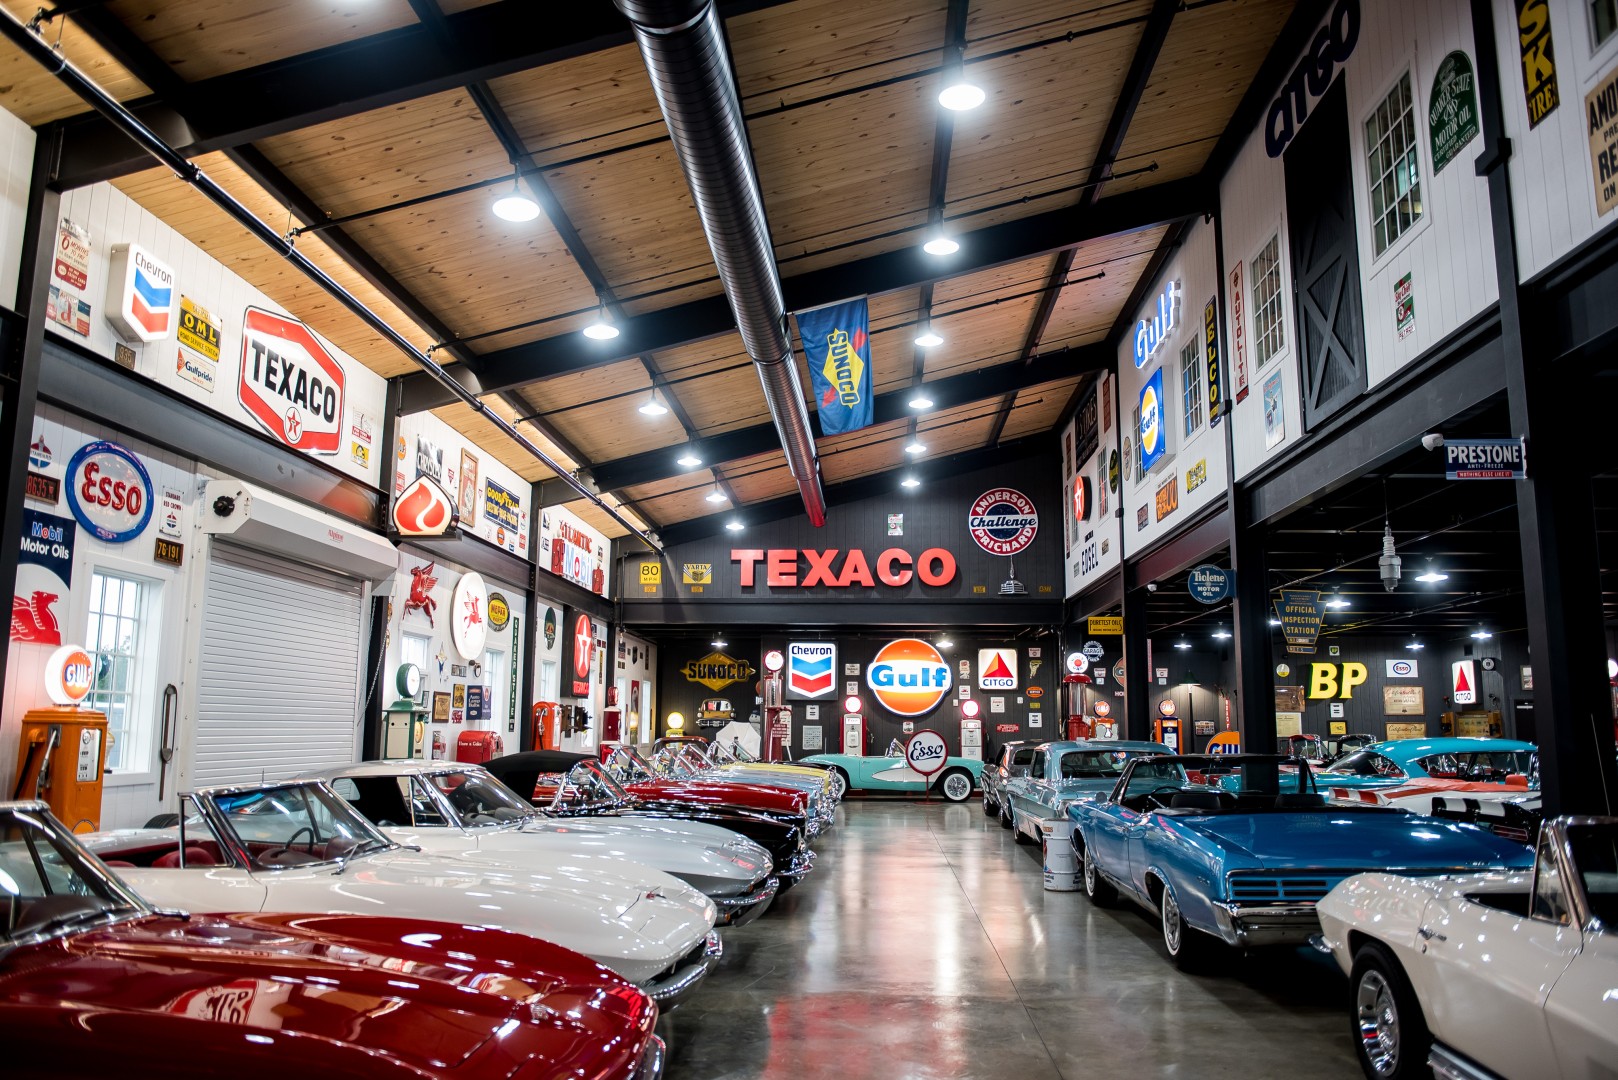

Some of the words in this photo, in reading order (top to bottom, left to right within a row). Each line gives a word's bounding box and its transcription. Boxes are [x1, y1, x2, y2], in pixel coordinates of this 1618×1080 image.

[1430, 84, 1451, 127] QUAKER
[1589, 76, 1618, 136] AMO
[1435, 116, 1458, 152] MOTOR
[1459, 105, 1472, 126] OIL
[135, 252, 172, 285] Chevron
[184, 313, 217, 343] OML
[1134, 281, 1174, 369] Gulf
[1234, 291, 1246, 388] AUTOLITE
[1205, 303, 1218, 403] DELCO
[185, 360, 213, 383] Gulfpride
[828, 332, 859, 404] SUNOCO
[251, 338, 336, 424] TEXACO
[1141, 405, 1156, 435] Gulf
[1447, 445, 1520, 463] PRESTONE
[975, 491, 1032, 515] ANDERSON
[31, 521, 63, 542] Mobil
[970, 516, 1037, 529] Challenge
[20, 536, 50, 555] Motor
[51, 544, 70, 560] Oils
[559, 520, 593, 554] ATLANTIC
[974, 527, 1033, 552] PRICHARD
[565, 543, 593, 586] Mobil
[641, 565, 659, 576] 80
[730, 546, 957, 588] TEXACO
[1081, 541, 1098, 576] EDSEL
[1281, 615, 1320, 624] INSPECTION
[1285, 605, 1317, 614] OFFICIAL
[1286, 626, 1315, 635] STATION
[791, 645, 832, 655] Chevron
[688, 662, 746, 680] SUNOCO
[871, 664, 947, 687] Gulf
[982, 678, 1014, 687] CITGO
[1308, 662, 1368, 699] BP
[1455, 691, 1472, 702] CITGO
[909, 740, 944, 761] Esso
